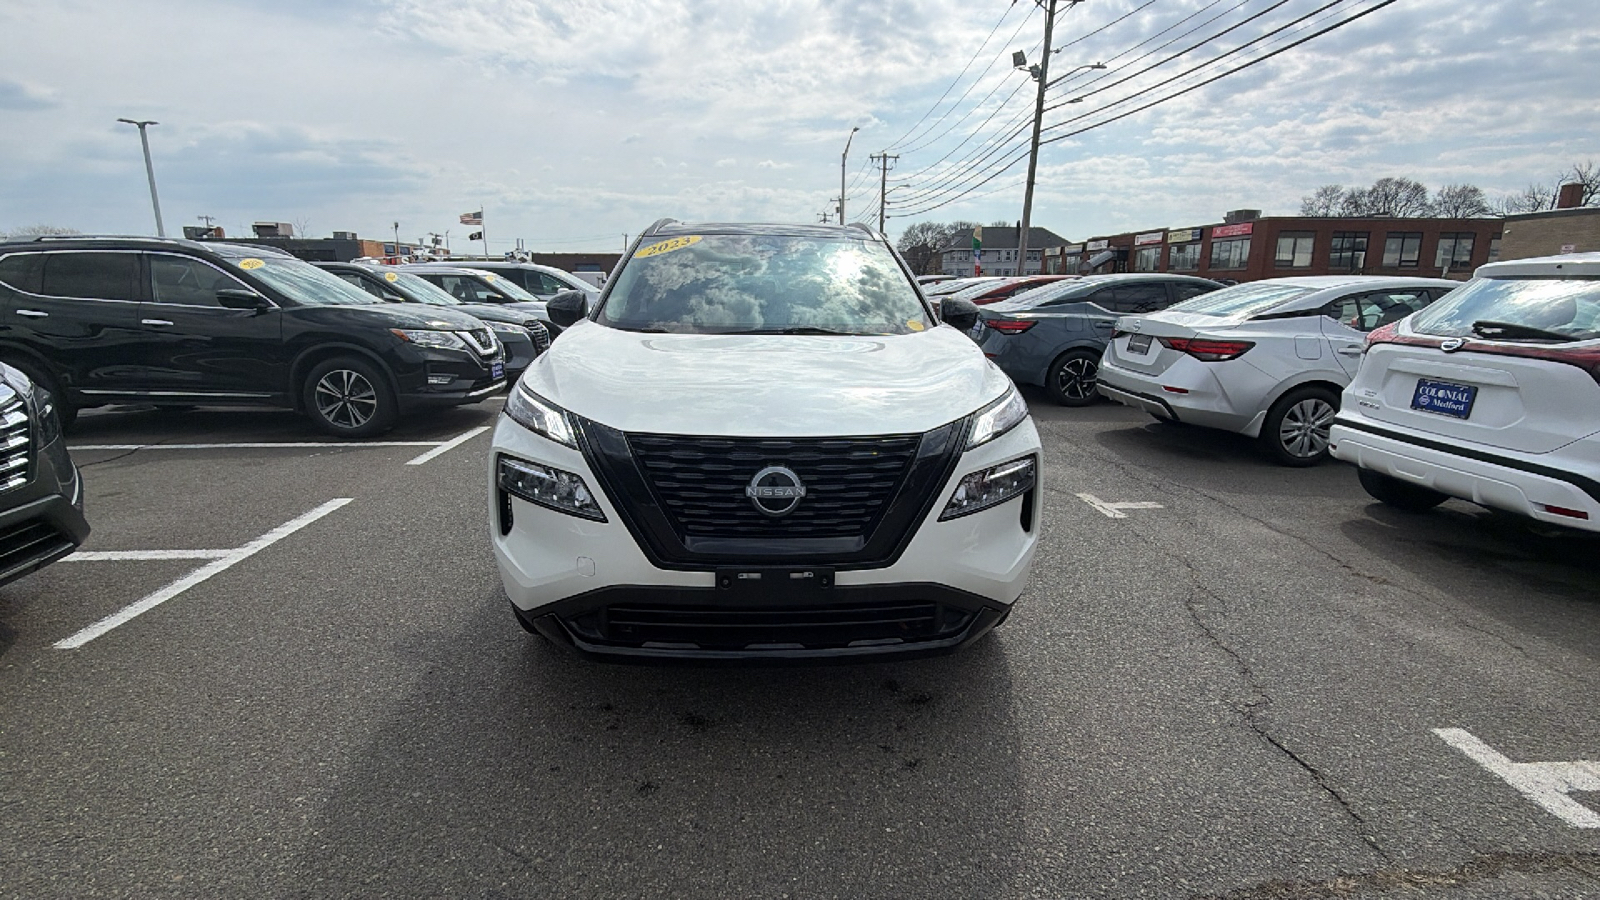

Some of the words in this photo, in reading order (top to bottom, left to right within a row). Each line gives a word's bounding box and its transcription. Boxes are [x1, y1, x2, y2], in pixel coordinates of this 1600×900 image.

[648, 237, 691, 256] 2023
[1419, 386, 1469, 403] COLONIAL
[1431, 399, 1465, 411] Medford
[747, 488, 804, 496] NISSAN
